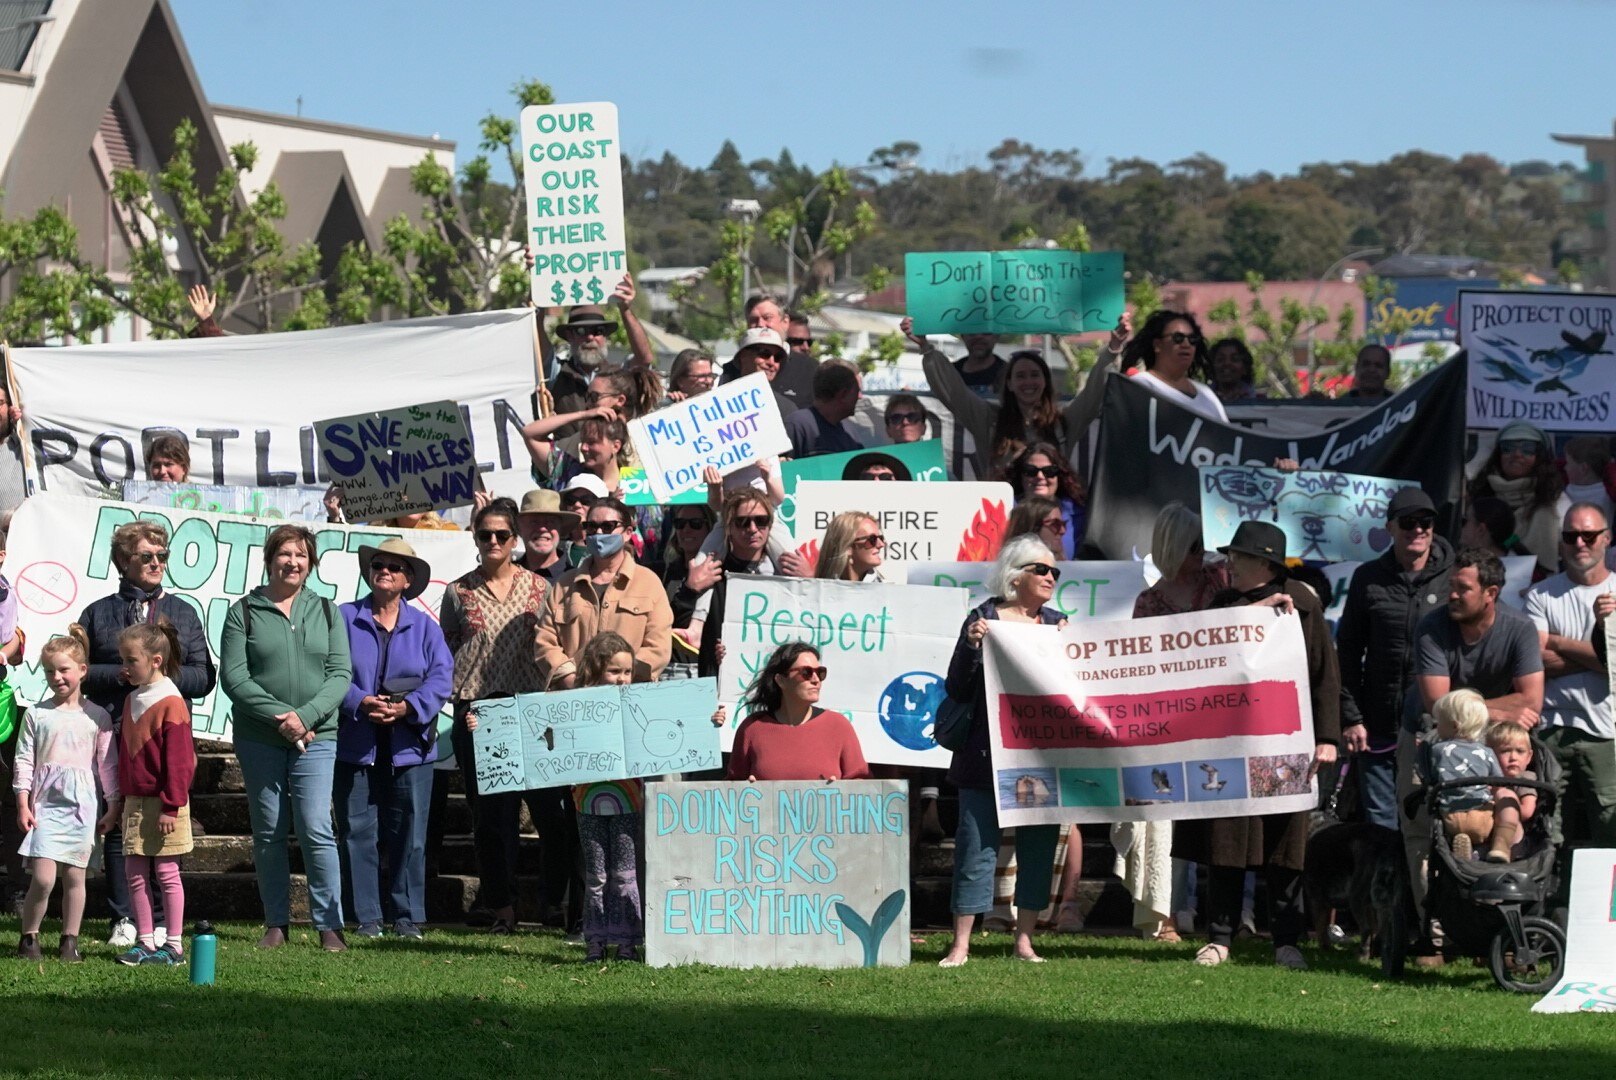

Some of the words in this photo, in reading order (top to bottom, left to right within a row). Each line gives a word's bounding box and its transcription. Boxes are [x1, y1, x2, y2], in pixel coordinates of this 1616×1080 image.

[536, 112, 595, 133] OUR
[529, 139, 613, 163] COAST
[541, 168, 599, 190] OUR
[537, 194, 600, 218] RISK
[532, 222, 607, 246] THEIR
[535, 250, 625, 275] PROFIT
[997, 258, 1053, 281] Trash
[1058, 261, 1092, 280] The
[973, 284, 1047, 304] ocean
[1471, 304, 1565, 333] PROTECT
[1569, 306, 1616, 336] OUR
[647, 418, 685, 446] My
[688, 388, 765, 433] future
[1472, 387, 1611, 422] WILDERNESS
[323, 416, 403, 477] SAVE
[436, 409, 456, 423] the
[717, 412, 760, 444] NOT
[1288, 400, 1417, 470] Wandoo
[370, 437, 472, 488] WHALERS
[664, 461, 701, 490] for
[706, 442, 754, 470] sale
[421, 465, 475, 504] WAY
[882, 542, 918, 560] ISK
[741, 591, 893, 652] Respect
[1105, 636, 1153, 657] THE
[1160, 625, 1265, 651] ROCKETS
[1160, 656, 1227, 674] WILDLIFE
[522, 699, 621, 736] RESPECT
[1011, 704, 1035, 719] NO
[1134, 703, 1150, 717] IN
[1155, 697, 1196, 715] THIS
[1200, 693, 1250, 710] AREA
[1011, 725, 1055, 740] WILD
[1061, 725, 1099, 739] LIFE
[1101, 725, 1123, 739] AT
[1128, 721, 1172, 738] RISK
[535, 751, 622, 782] PROTECT
[656, 787, 763, 837] DOING
[778, 787, 907, 837] NOTHING
[714, 834, 838, 885] RISKS
[664, 885, 846, 946] EVERYTHING
